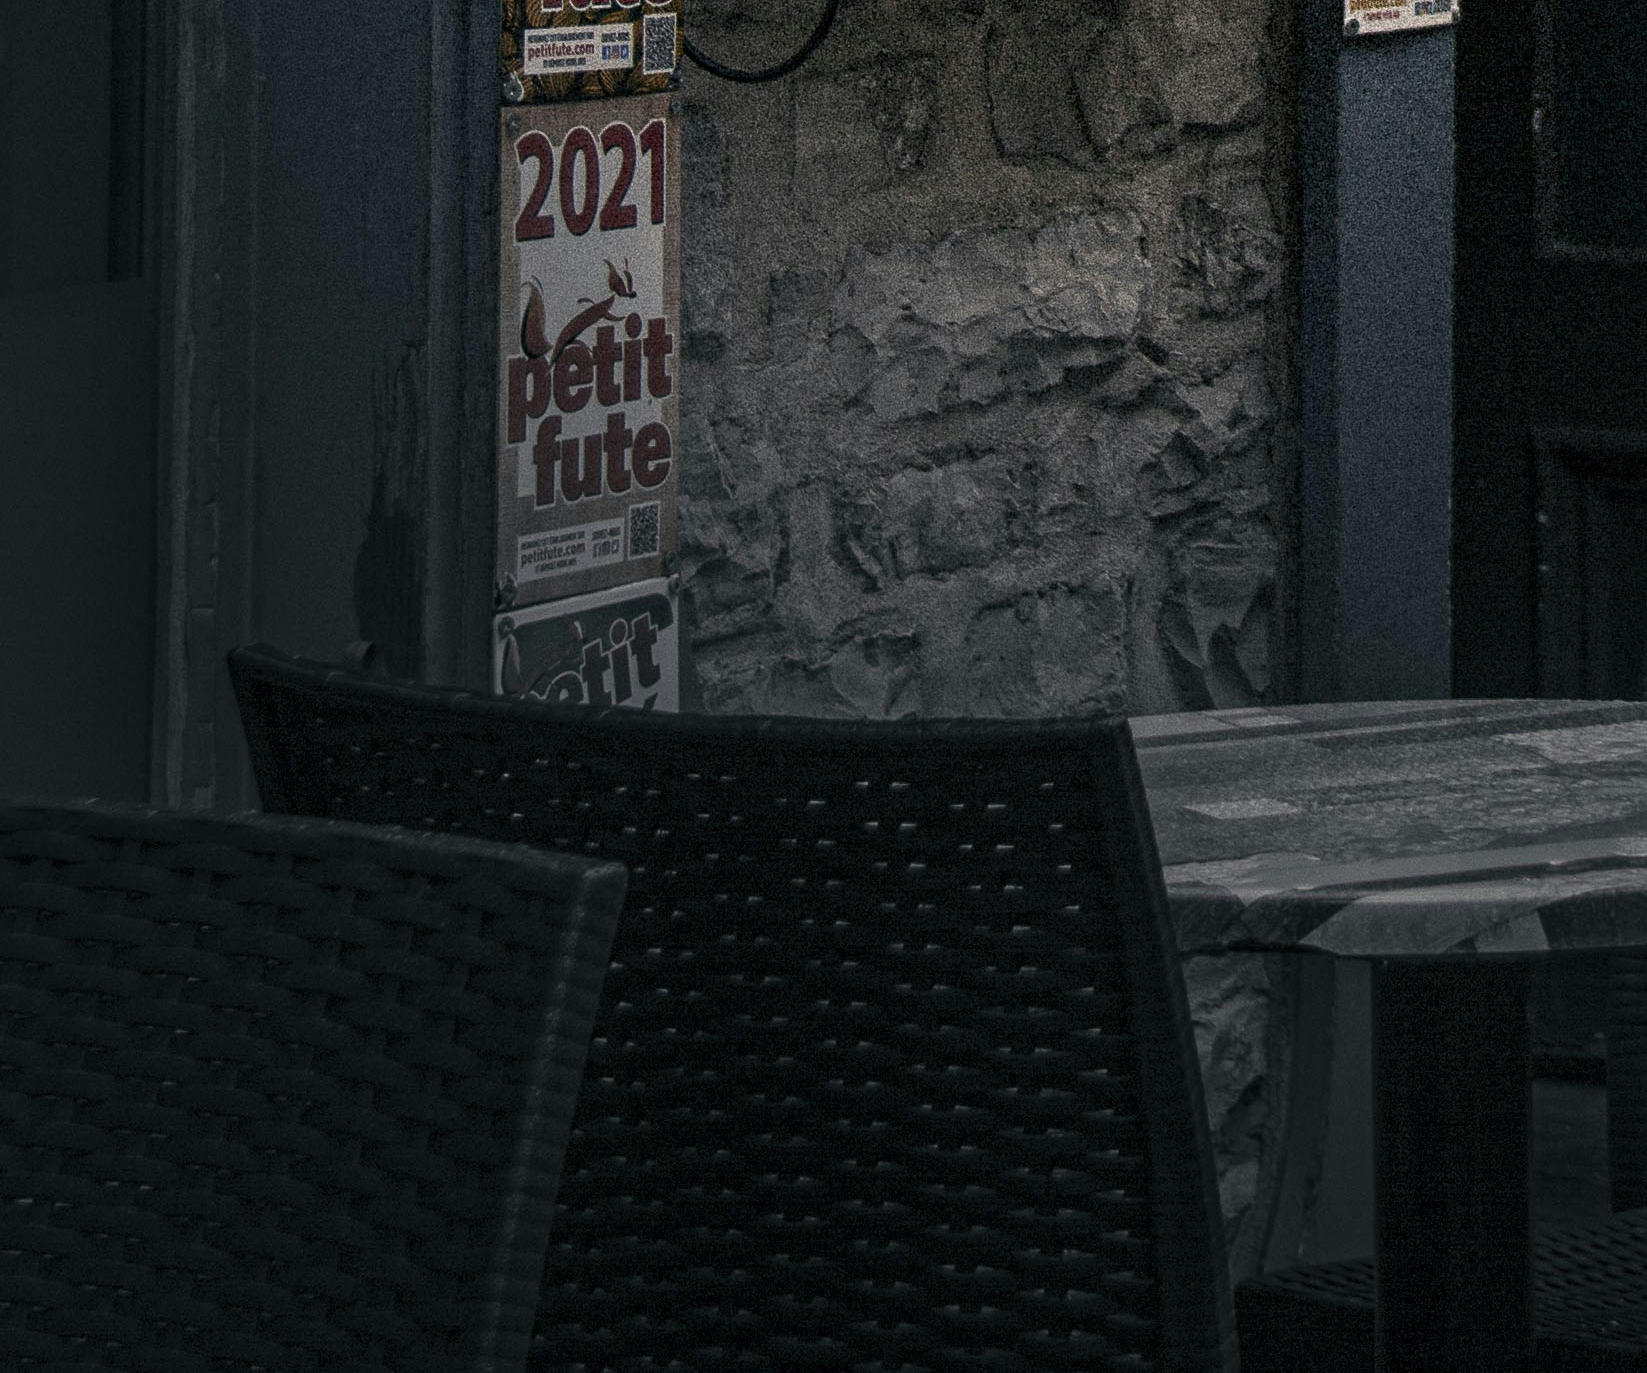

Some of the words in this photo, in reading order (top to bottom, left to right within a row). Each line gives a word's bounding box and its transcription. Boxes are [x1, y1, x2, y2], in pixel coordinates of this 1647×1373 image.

[527, 42, 595, 61] petitfute.com
[515, 119, 666, 242] 2021
[507, 313, 673, 444] petit
[532, 412, 673, 507] fute
[520, 543, 586, 567] petitfute.com
